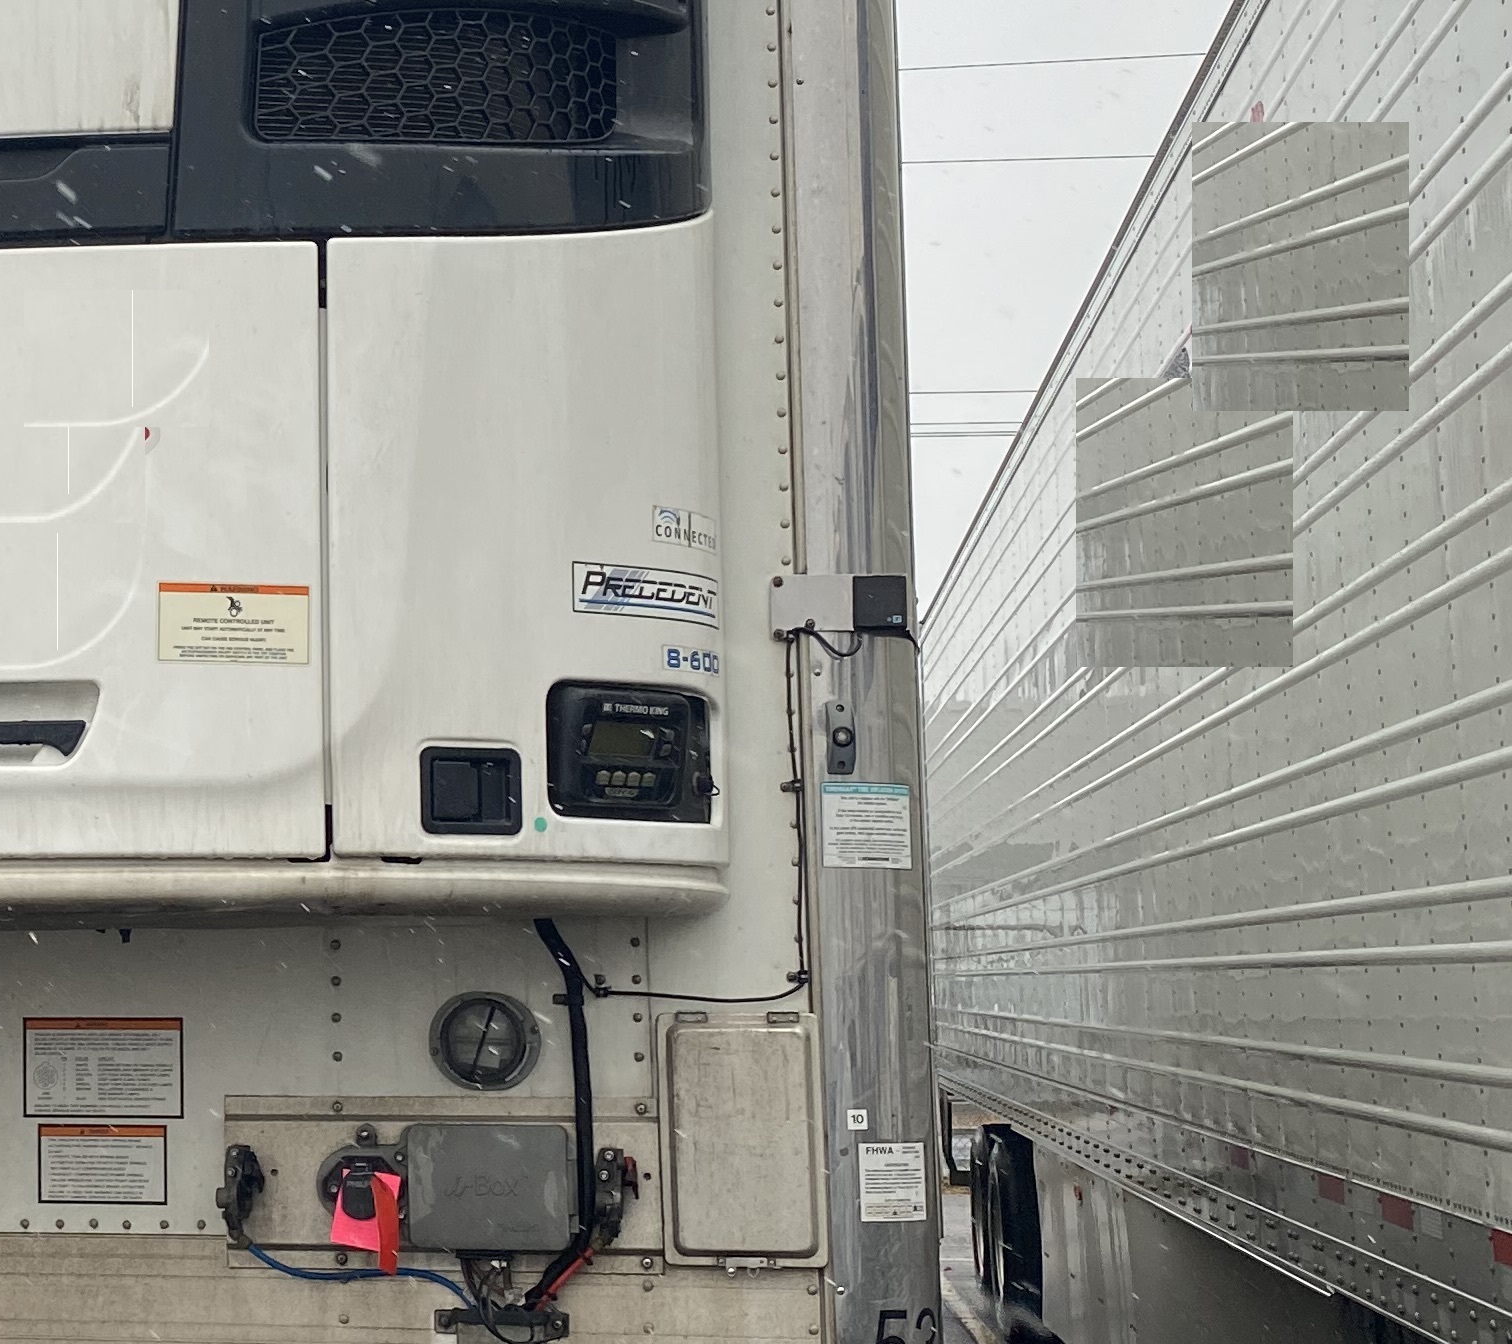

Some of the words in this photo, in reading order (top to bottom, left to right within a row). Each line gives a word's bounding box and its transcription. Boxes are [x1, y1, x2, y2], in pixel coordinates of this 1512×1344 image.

[615, 703, 648, 715] THERMO
[649, 704, 669, 716] KING
[851, 1114, 864, 1124] 10
[866, 1146, 894, 1155] FHWA
